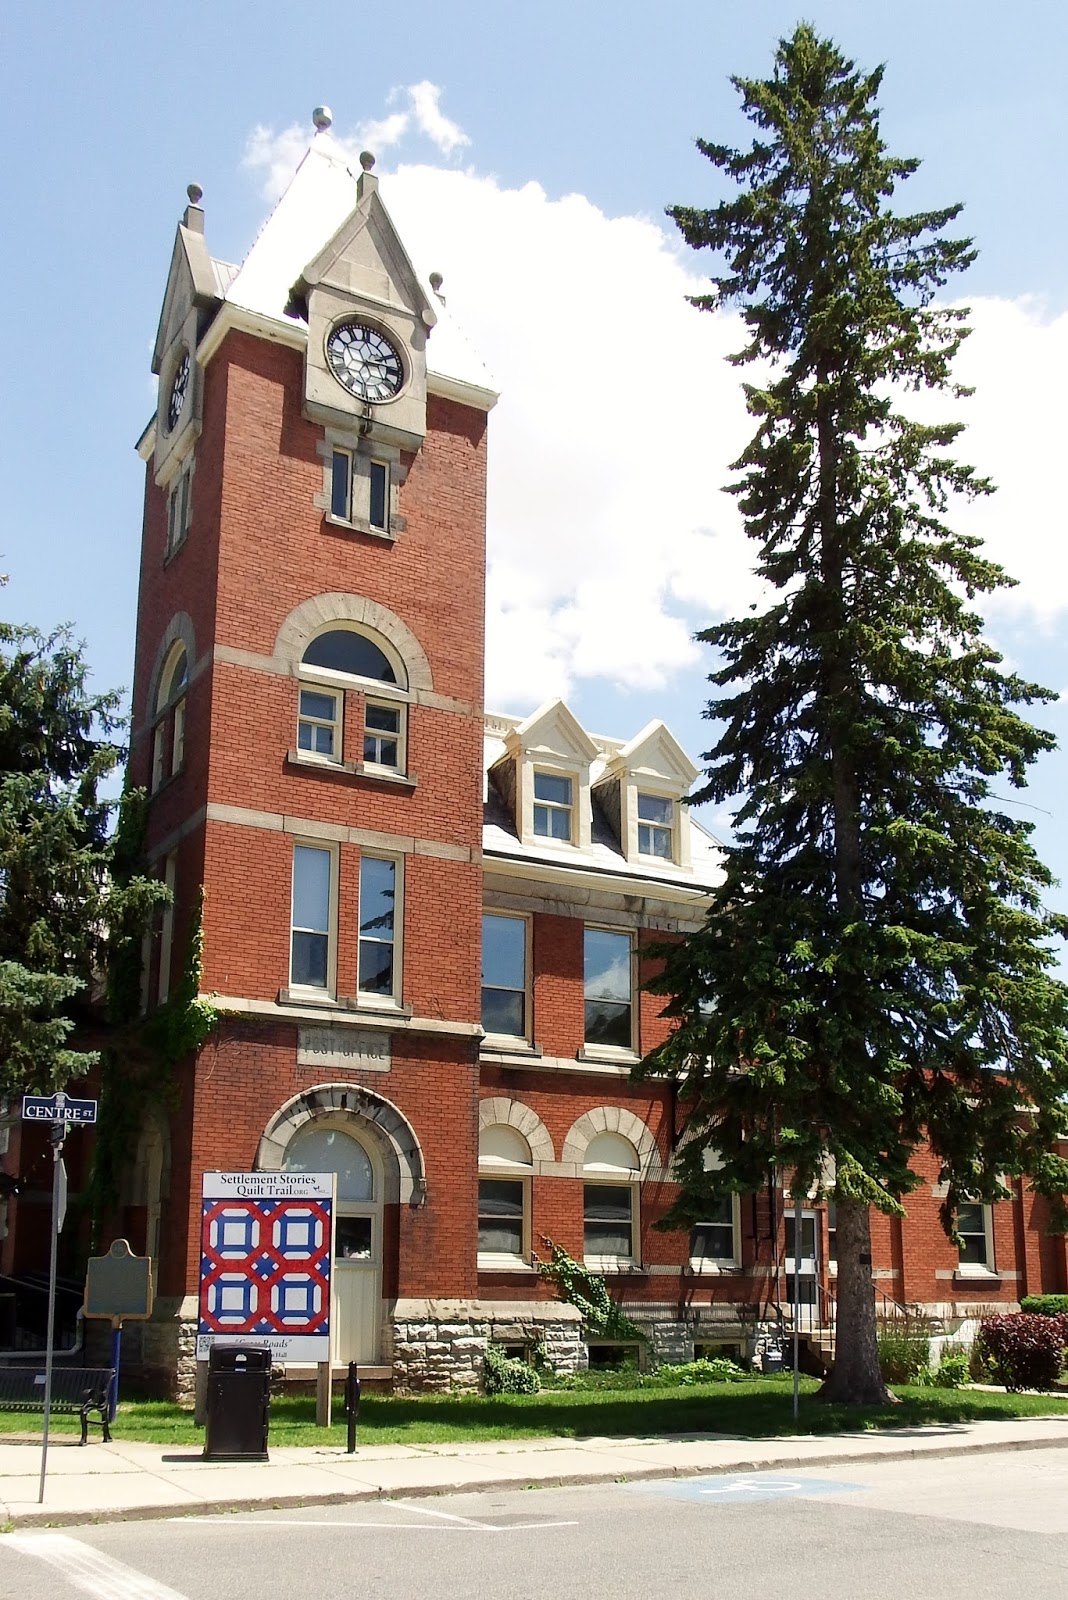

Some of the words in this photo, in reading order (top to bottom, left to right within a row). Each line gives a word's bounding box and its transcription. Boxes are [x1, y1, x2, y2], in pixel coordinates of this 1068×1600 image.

[304, 1037, 335, 1055] POST
[342, 1040, 385, 1060] OFFICE
[26, 1105, 81, 1119] CENTRE
[220, 1174, 277, 1184] Settlement
[279, 1174, 316, 1184] Stories
[236, 1185, 264, 1197] Quilt
